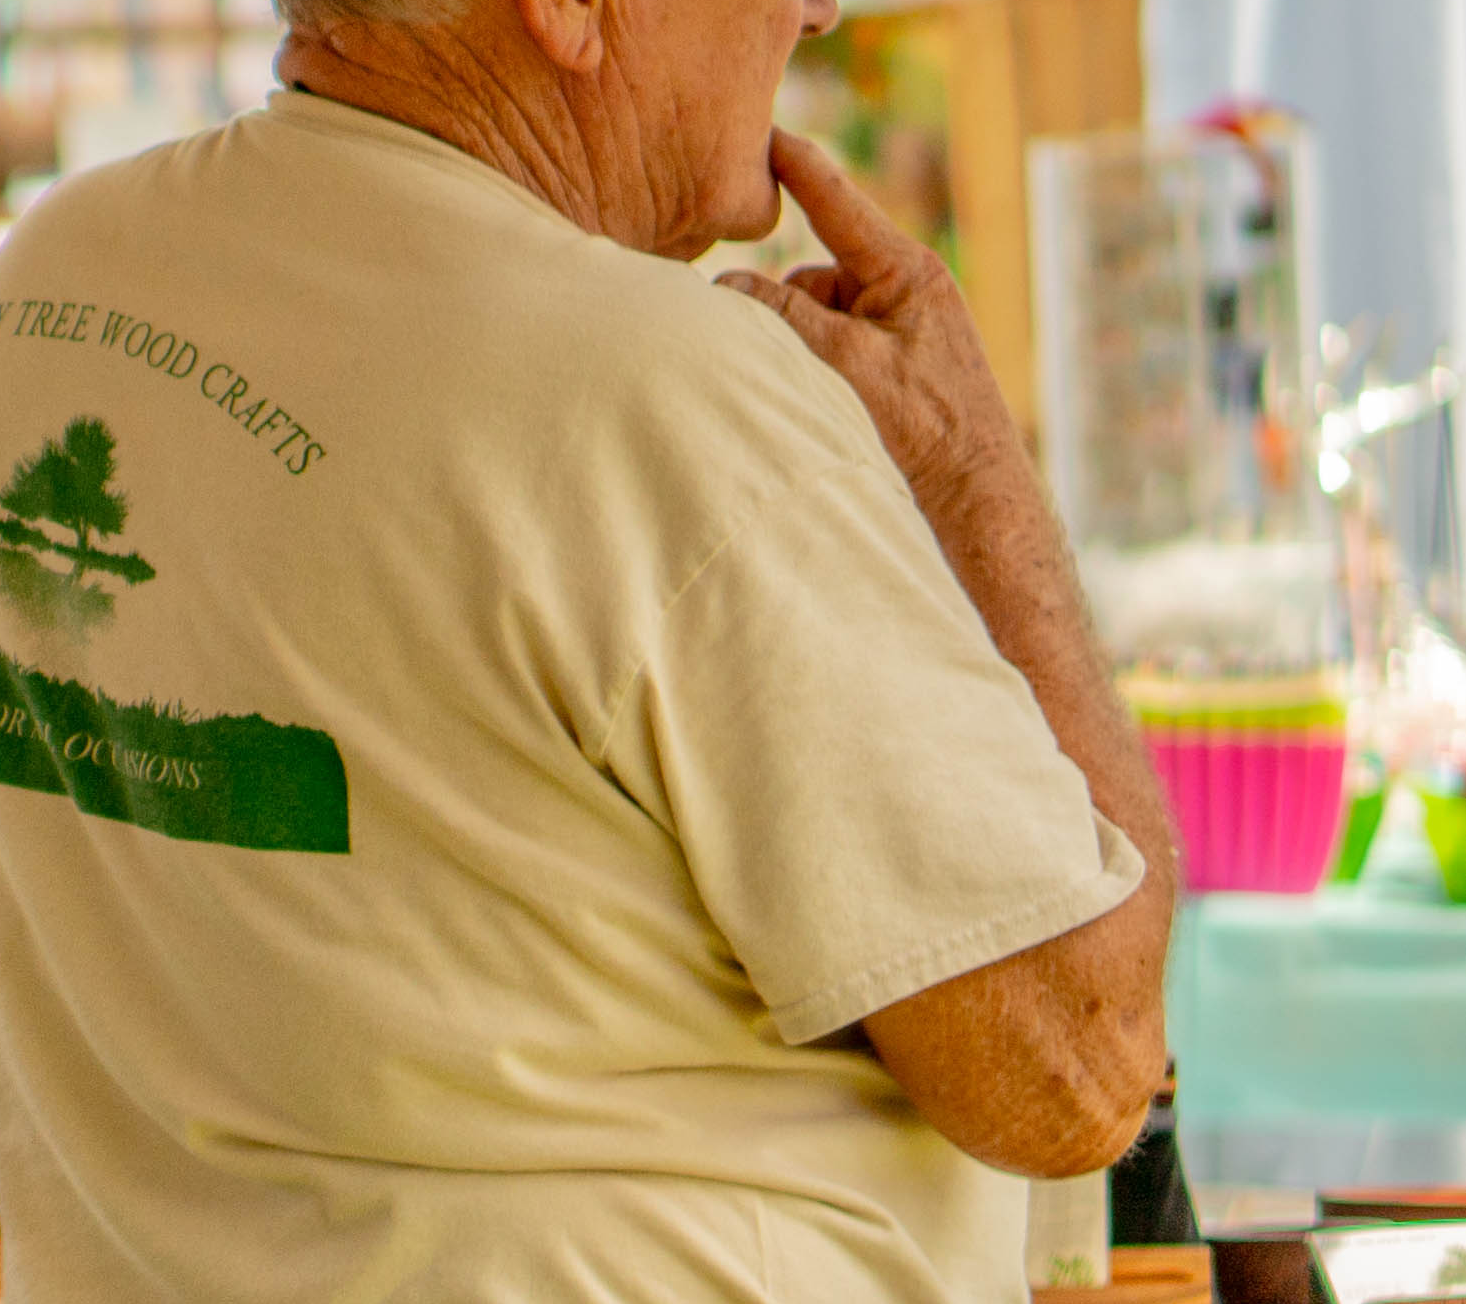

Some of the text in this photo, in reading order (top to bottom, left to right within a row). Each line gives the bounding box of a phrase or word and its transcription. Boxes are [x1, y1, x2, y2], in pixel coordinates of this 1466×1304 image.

[13, 299, 97, 342] TREE
[100, 310, 199, 379] WOOD
[200, 363, 327, 476] CRAFTS
